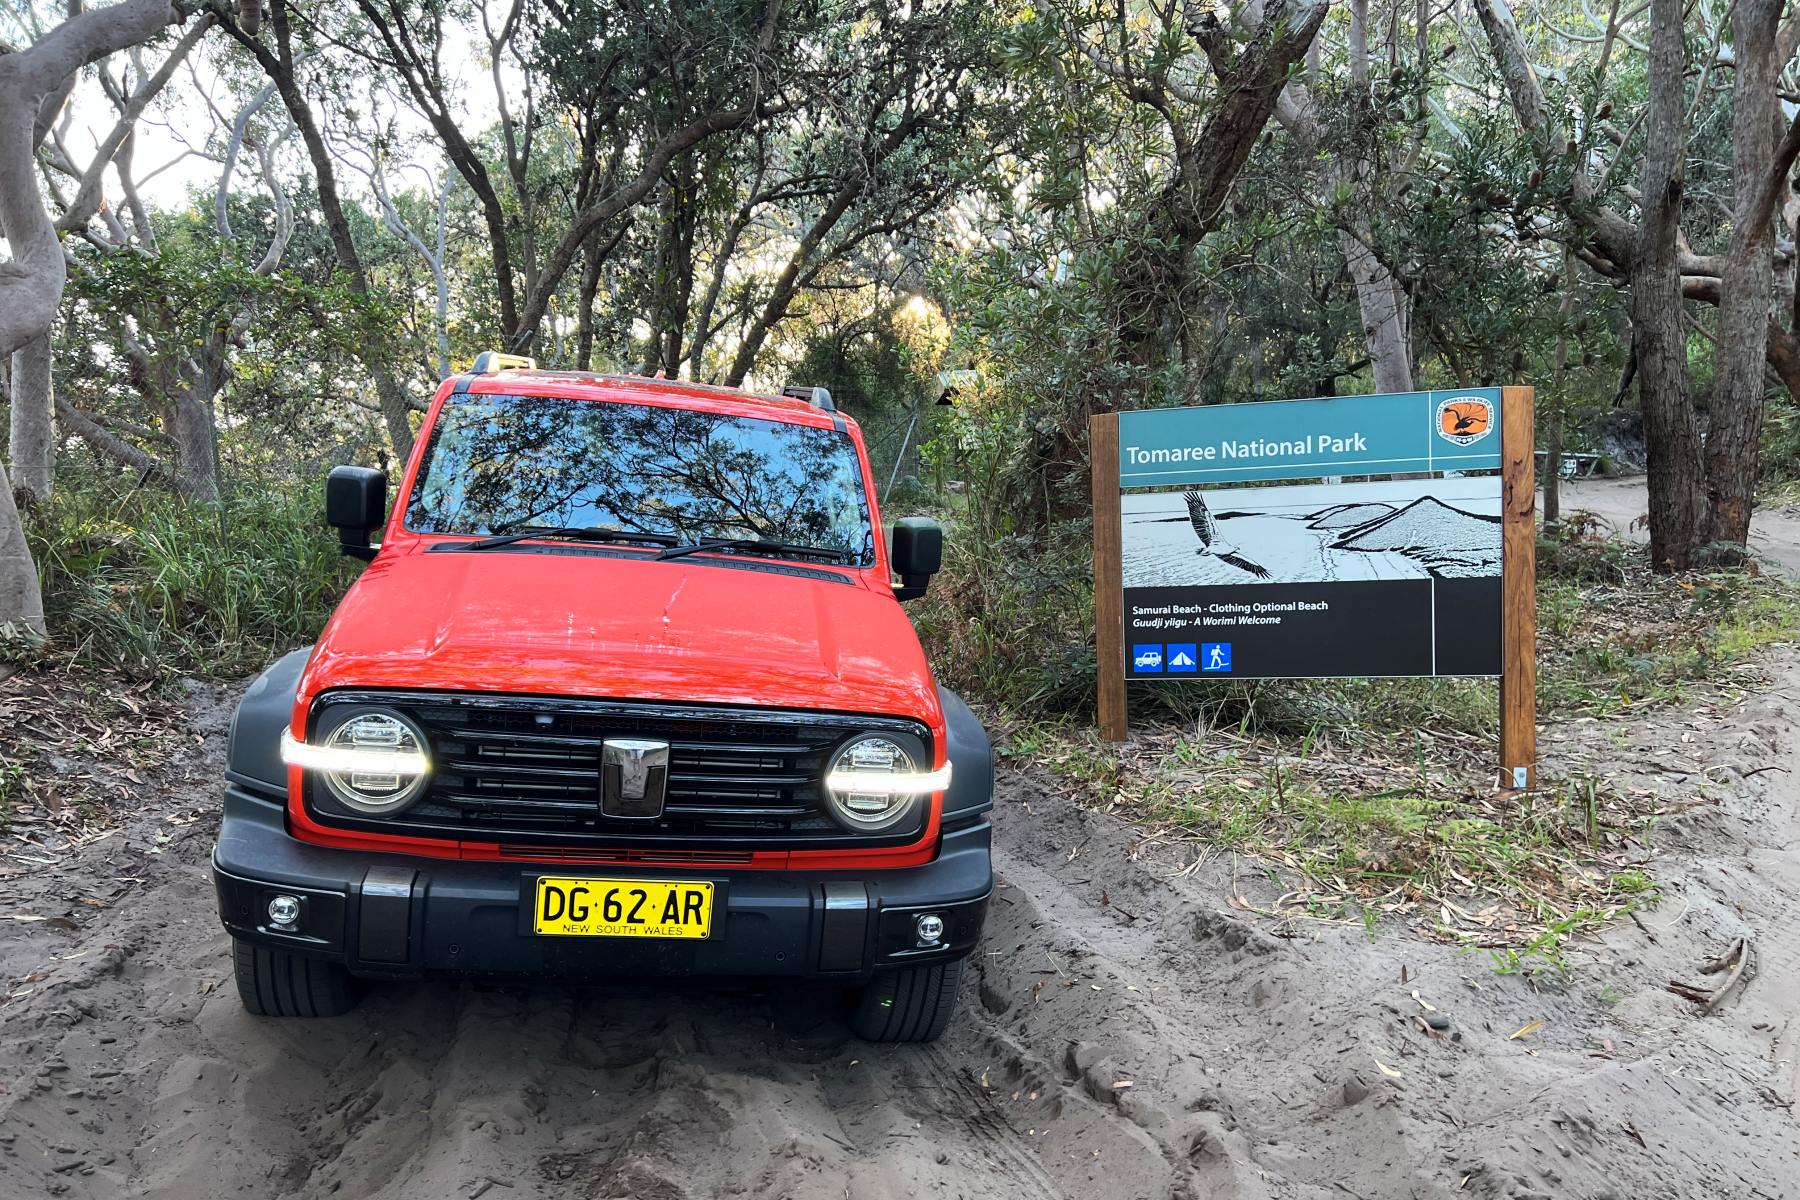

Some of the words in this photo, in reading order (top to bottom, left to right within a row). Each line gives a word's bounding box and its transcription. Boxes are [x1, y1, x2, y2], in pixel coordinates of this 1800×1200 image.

[1126, 445, 1216, 464] Tomaree
[1222, 436, 1312, 459] National
[1318, 433, 1367, 453] Park
[1132, 605, 1171, 615] Samurai
[1173, 605, 1201, 614] Beach
[1209, 603, 1251, 615] Clothing
[1253, 602, 1296, 613] Optional
[1298, 601, 1329, 611] Beach
[1132, 617, 1164, 629] Guudji
[1194, 617, 1201, 626] A
[1203, 616, 1236, 626] Worimi
[1238, 615, 1281, 625] Welcome
[562, 924, 591, 933] NEW
[596, 925, 637, 935] SOUTH
[644, 925, 683, 936] WALES
